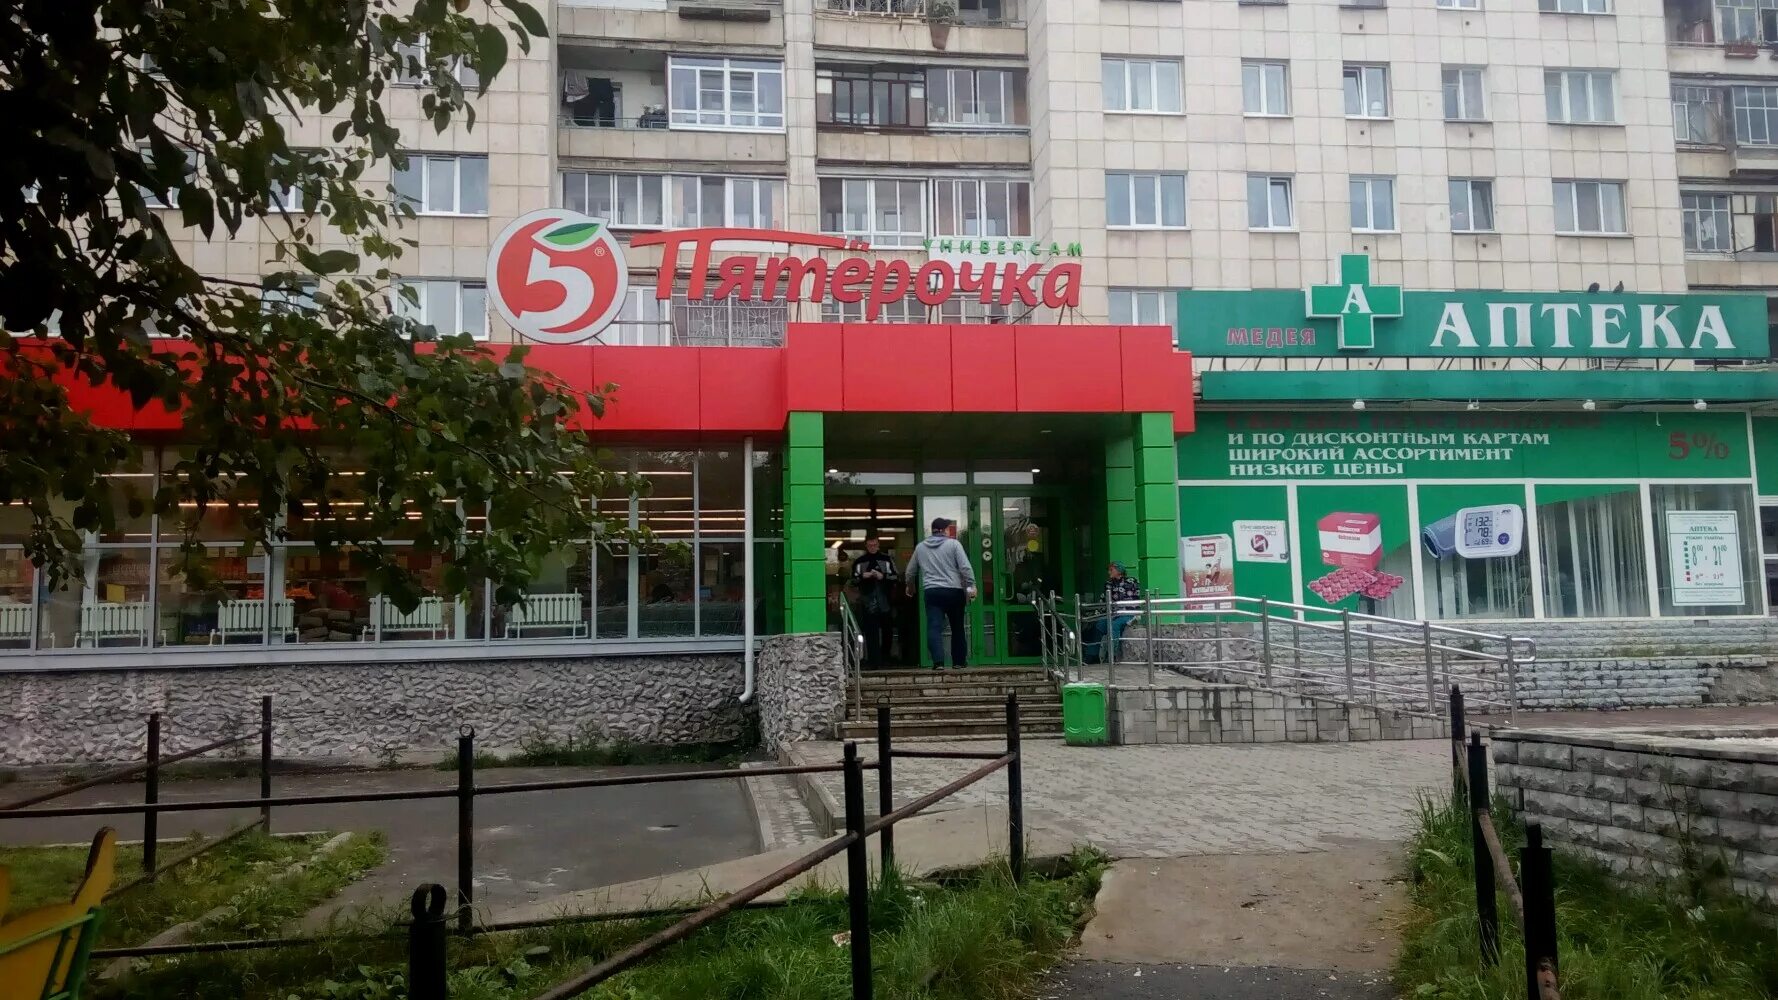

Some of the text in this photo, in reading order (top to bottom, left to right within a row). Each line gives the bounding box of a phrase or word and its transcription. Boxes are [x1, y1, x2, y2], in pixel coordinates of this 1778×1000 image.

[922, 239, 1085, 257] УНИВЕРСАМ
[518, 247, 595, 331] 5
[1430, 302, 1736, 349] АПТЕКА
[1226, 327, 1316, 346] МЕДЕЯ
[1228, 432, 1550, 447] И ПО ДИСКОНТНЫМ КАРТАМ
[1669, 432, 1729, 460] 5%
[1229, 446, 1513, 461] ШИРОКИЙ АССОРТИМЕНТ
[1229, 462, 1404, 477] НИЗКИЕ ЦЕНЫ
